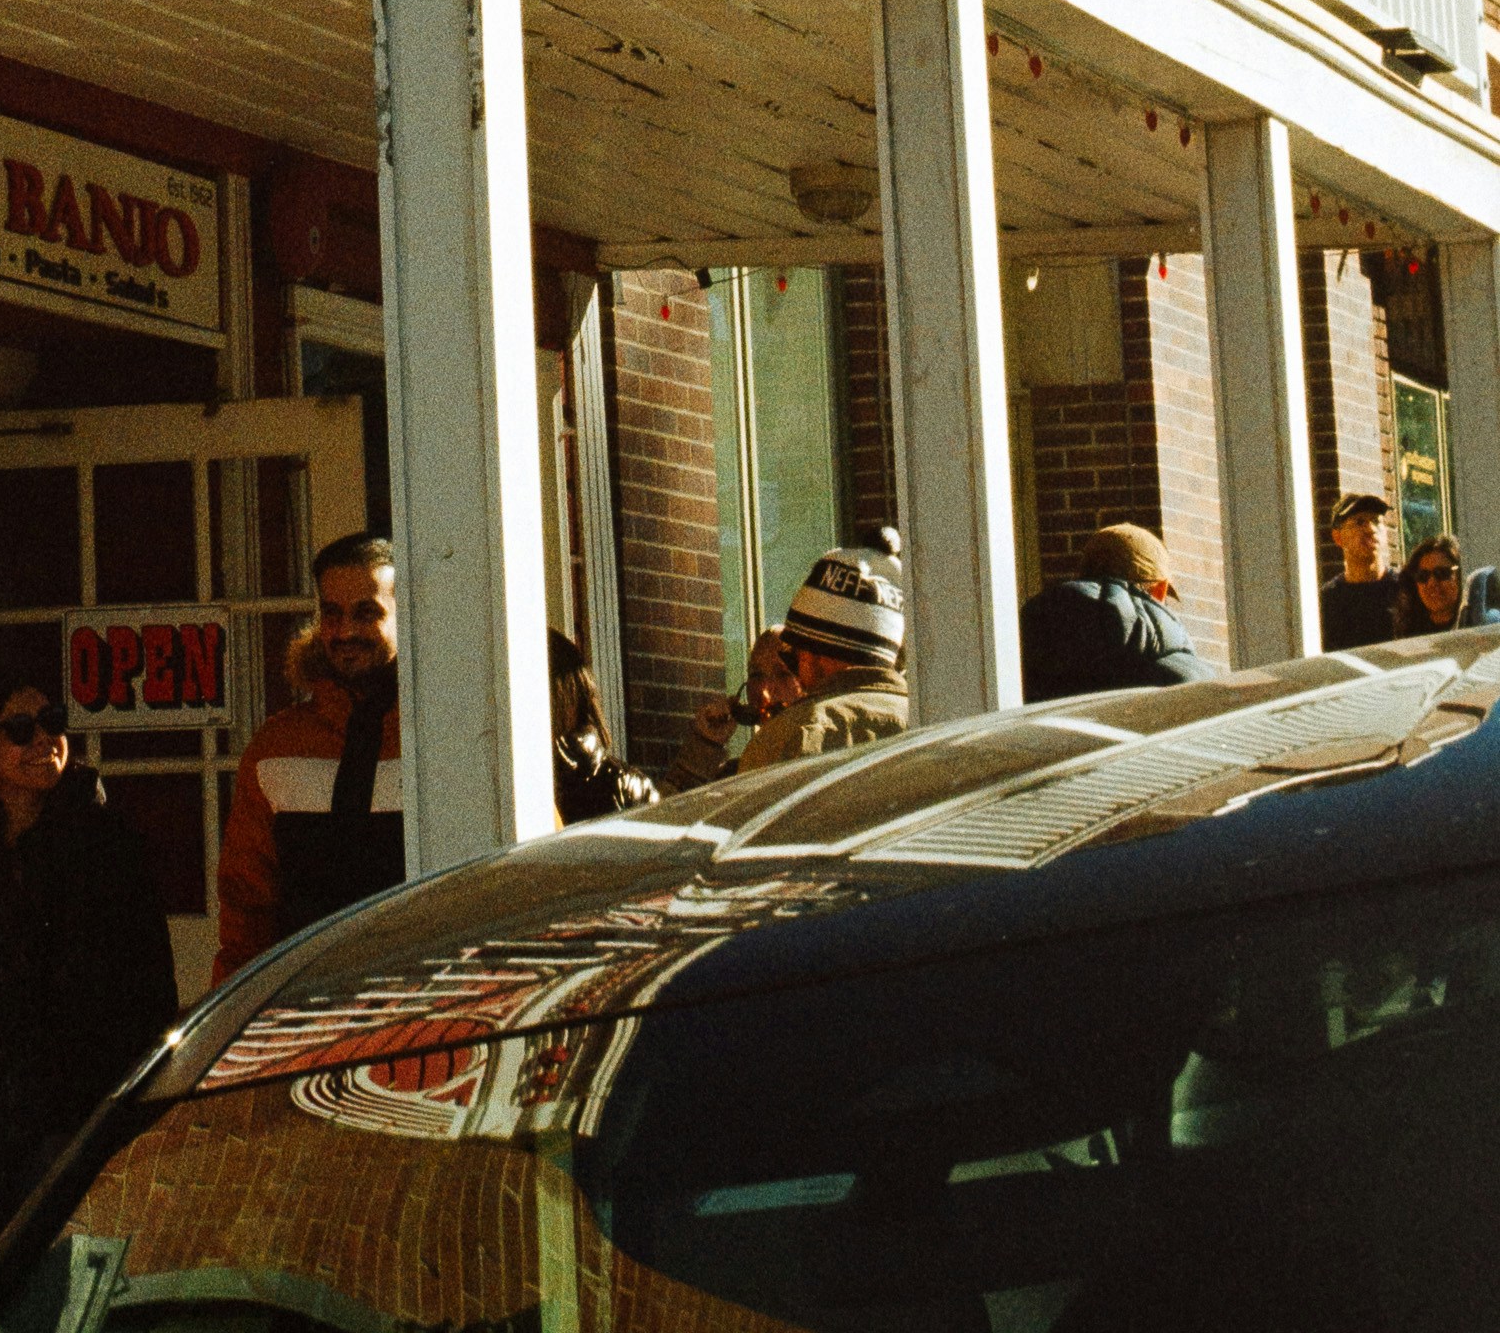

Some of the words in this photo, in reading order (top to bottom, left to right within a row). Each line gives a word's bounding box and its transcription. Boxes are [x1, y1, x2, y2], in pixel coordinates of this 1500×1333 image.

[3, 157, 201, 278] BANJO
[25, 248, 82, 286] Pasta
[105, 272, 169, 309] Salads
[819, 563, 869, 597] NEFF
[71, 622, 226, 712] OPEN
